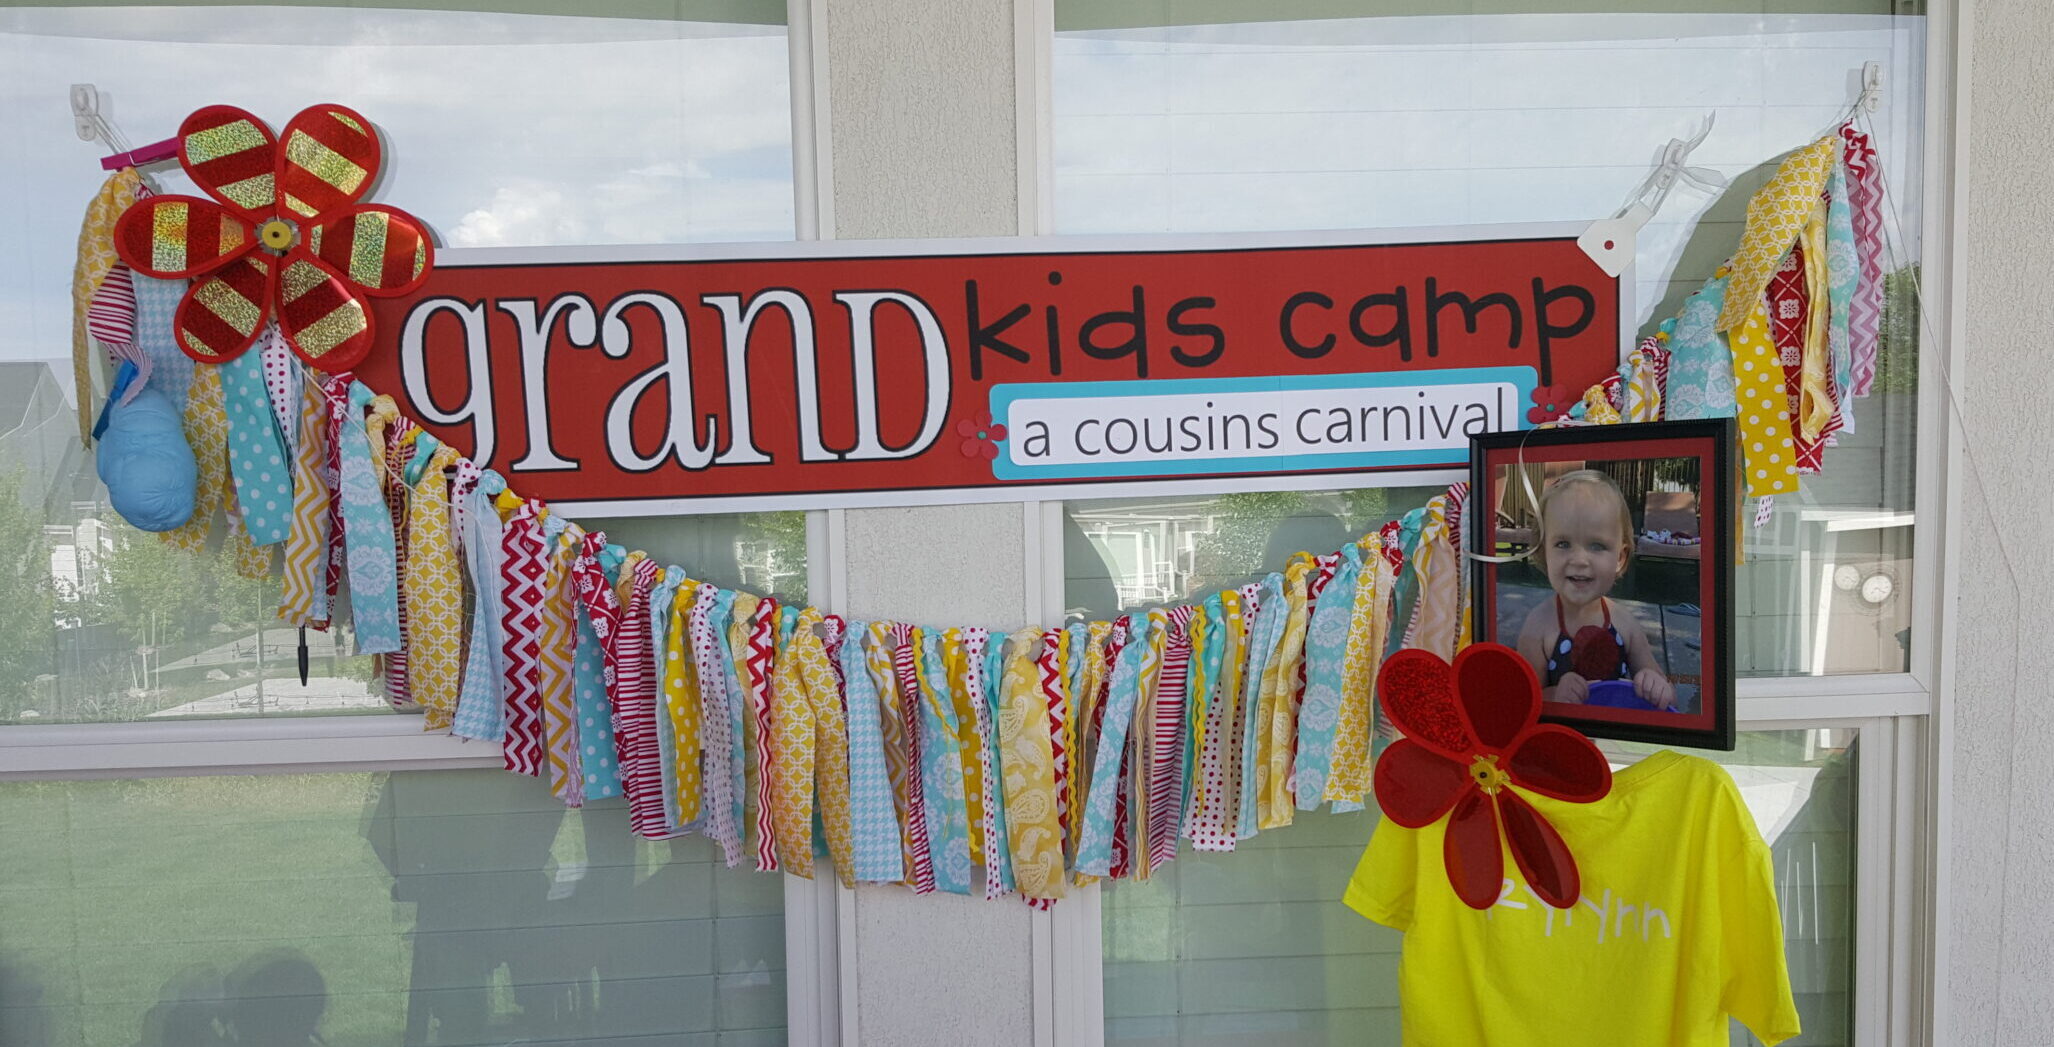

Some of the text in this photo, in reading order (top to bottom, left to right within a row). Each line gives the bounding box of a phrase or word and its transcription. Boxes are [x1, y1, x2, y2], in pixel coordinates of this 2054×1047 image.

[964, 270, 1226, 381] kids
[1278, 276, 1595, 387] camp
[1022, 386, 1503, 457] a cousins carnival
